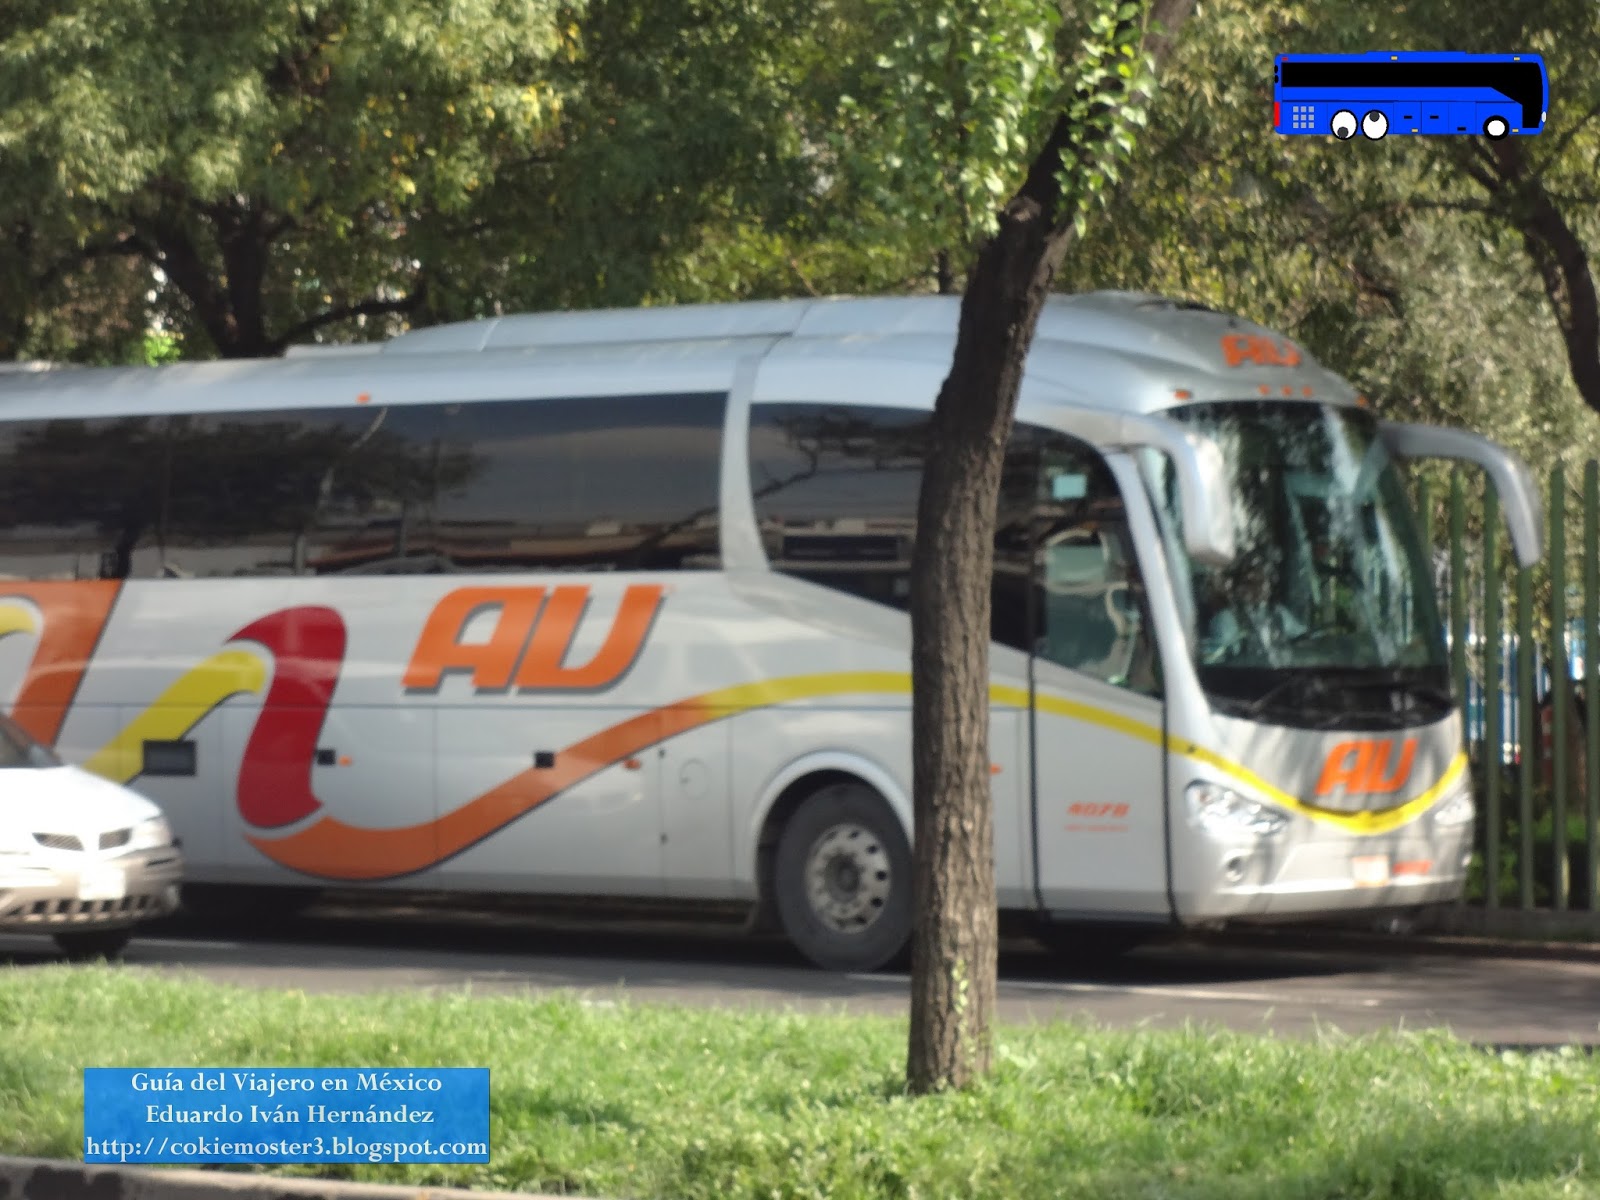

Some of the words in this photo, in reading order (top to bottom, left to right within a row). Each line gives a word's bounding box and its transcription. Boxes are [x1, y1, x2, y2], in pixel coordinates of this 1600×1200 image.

[1220, 334, 1301, 367] AU
[401, 584, 666, 694] AU
[1315, 739, 1418, 795] AU
